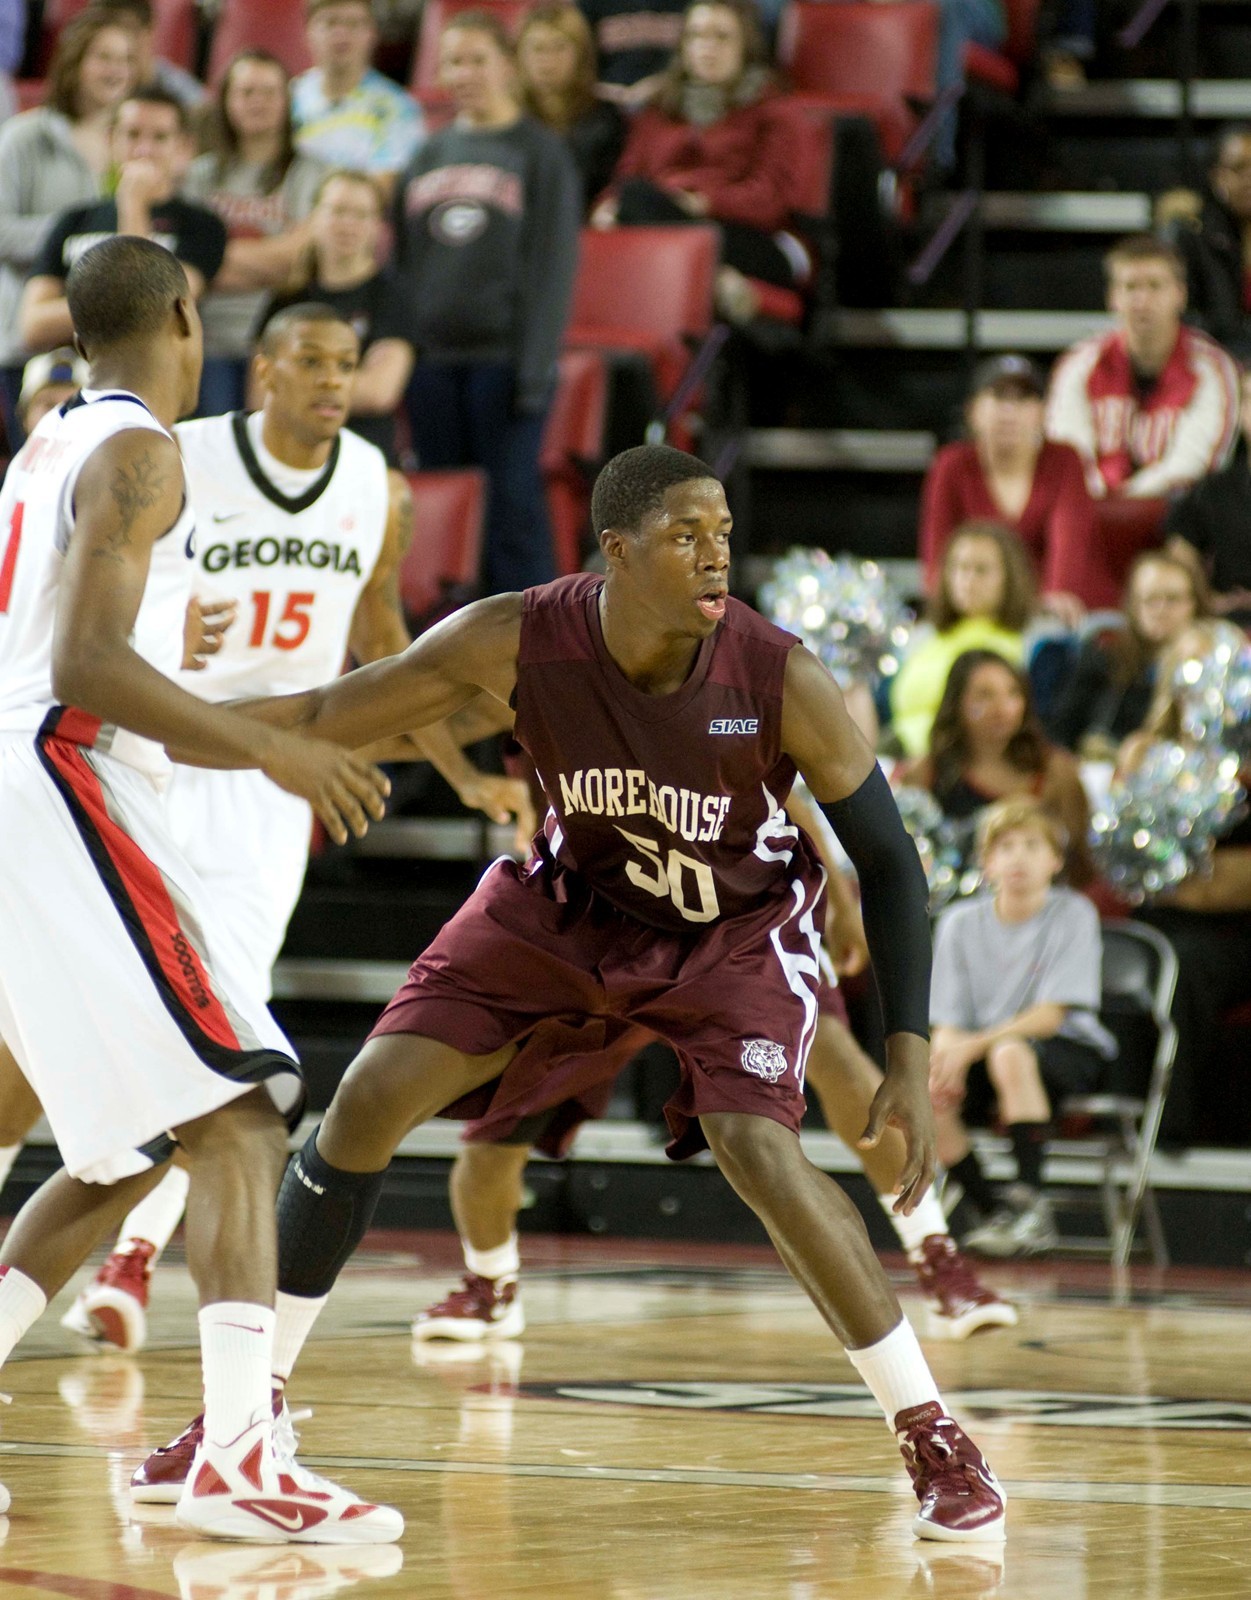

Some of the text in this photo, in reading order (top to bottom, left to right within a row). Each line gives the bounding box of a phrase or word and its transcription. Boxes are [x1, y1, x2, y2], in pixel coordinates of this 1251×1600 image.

[202, 537, 362, 577] GEORGIA
[250, 591, 315, 652] 15
[708, 719, 758, 734] SIAC
[612, 825, 720, 923] 50
